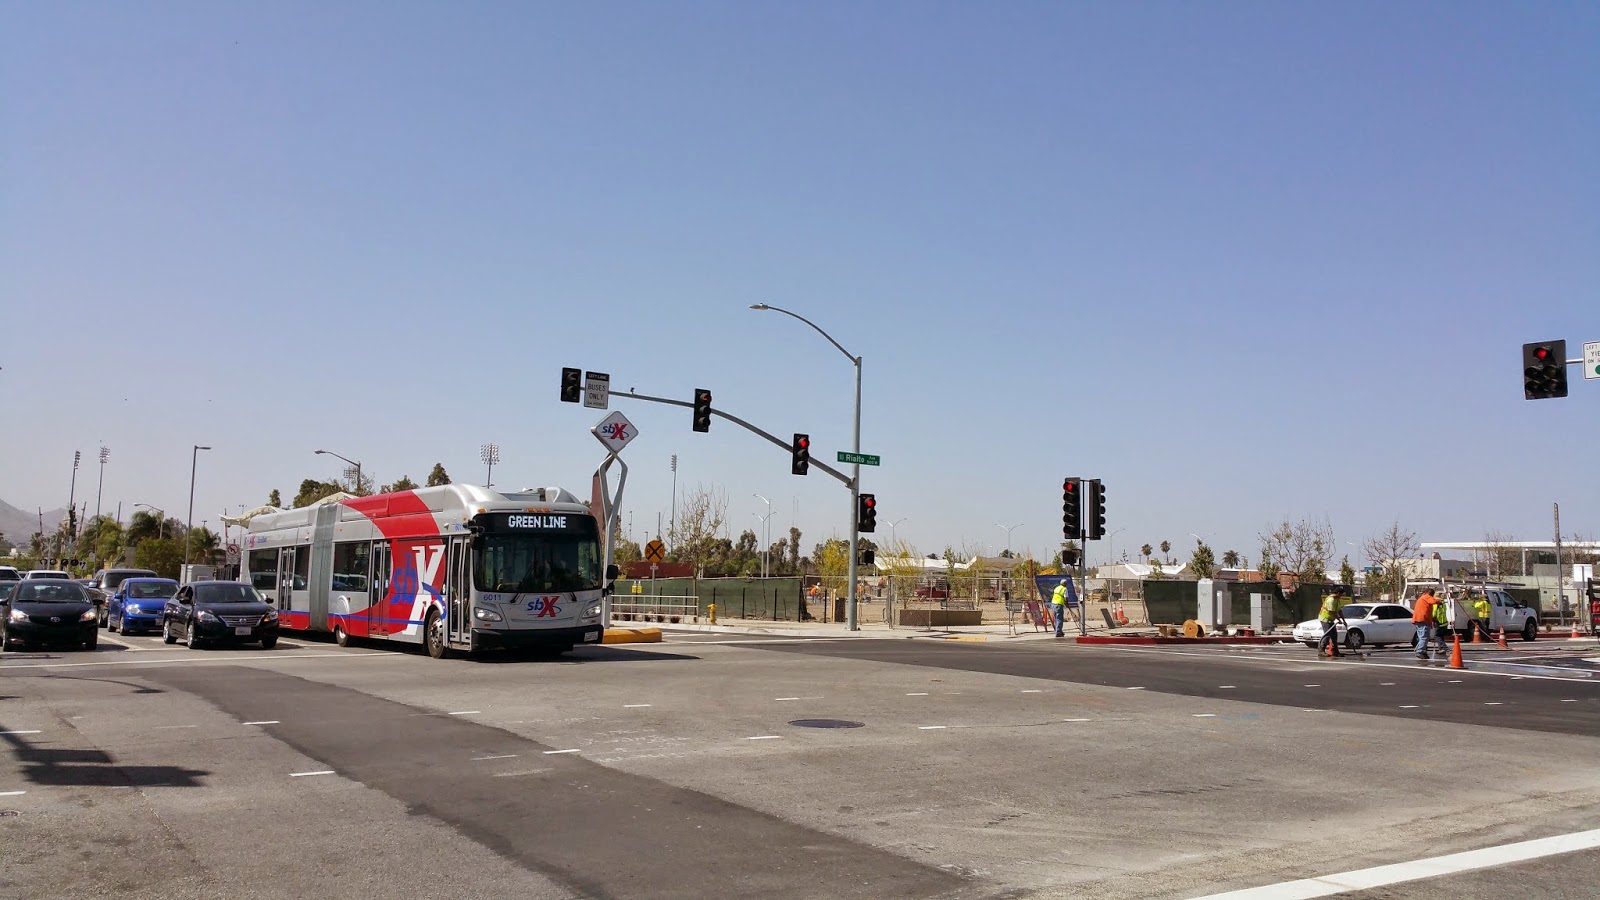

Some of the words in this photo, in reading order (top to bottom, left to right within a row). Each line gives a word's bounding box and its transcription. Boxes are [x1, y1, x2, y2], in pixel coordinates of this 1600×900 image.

[588, 383, 606, 391] BUSES
[589, 392, 604, 400] ONLY
[846, 454, 864, 463] Rialto
[508, 515, 542, 528] GREEN
[543, 516, 567, 528] LINE
[526, 596, 560, 618] sbX
